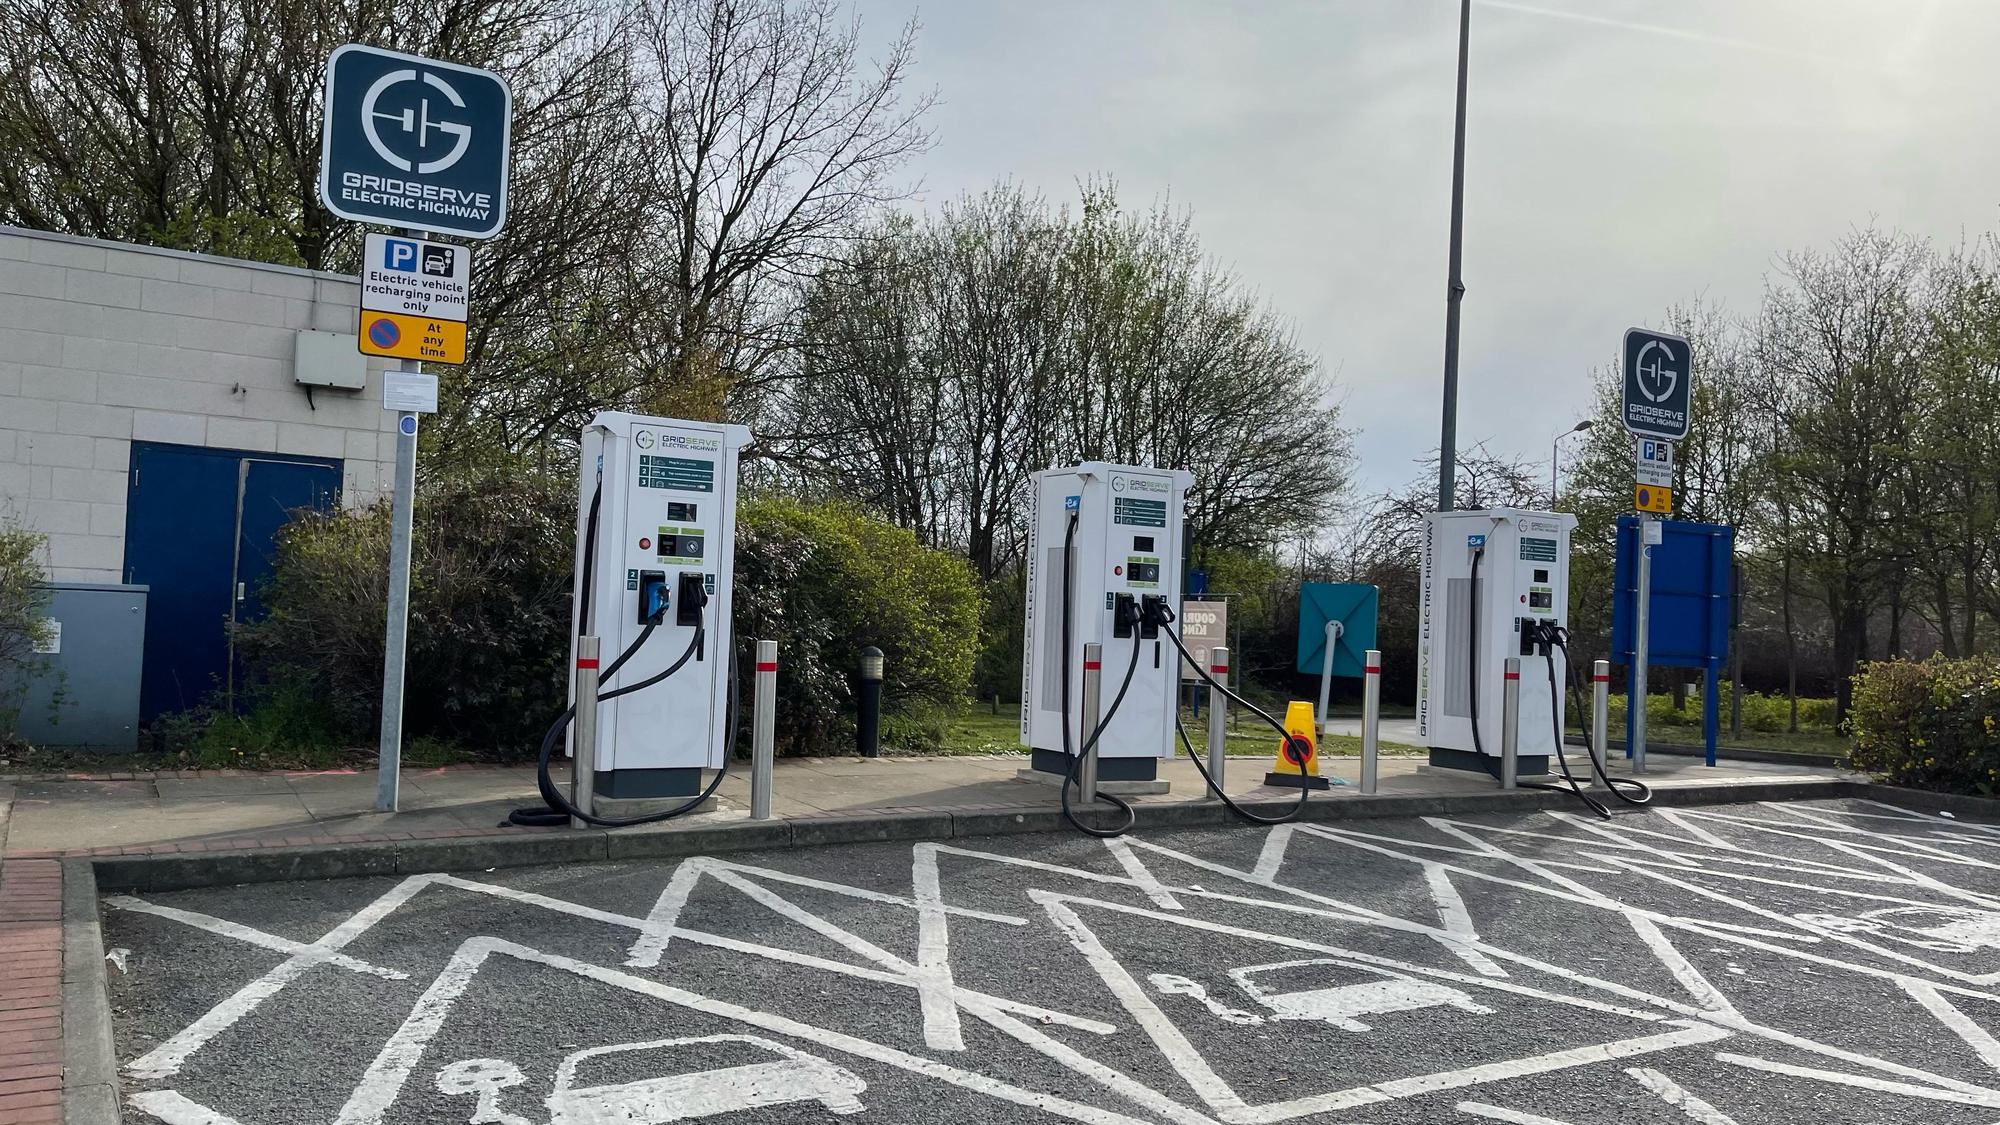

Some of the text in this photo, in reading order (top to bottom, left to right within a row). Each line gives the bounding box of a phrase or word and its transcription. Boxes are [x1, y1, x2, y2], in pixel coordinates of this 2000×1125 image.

[342, 172, 491, 208] GRIDSERVE
[342, 188, 490, 221] ELECTRIC HIGHWAY
[392, 243, 413, 267] P
[370, 271, 463, 293] Electric vehicle
[366, 284, 466, 305] recharging point
[403, 301, 429, 313] only
[427, 322, 441, 333] At
[423, 336, 444, 347] any
[420, 346, 446, 358] time
[1629, 403, 1684, 421] GRIDSERVE
[1629, 413, 1684, 429] ELECTRIC HIGHWAY
[662, 442, 689, 450] ELECTRIC
[663, 435, 718, 446] GRIDSERVE
[1646, 443, 1654, 458] P
[1420, 520, 1433, 737] GRIDSERVE ELECTRIC HIGHWAY
